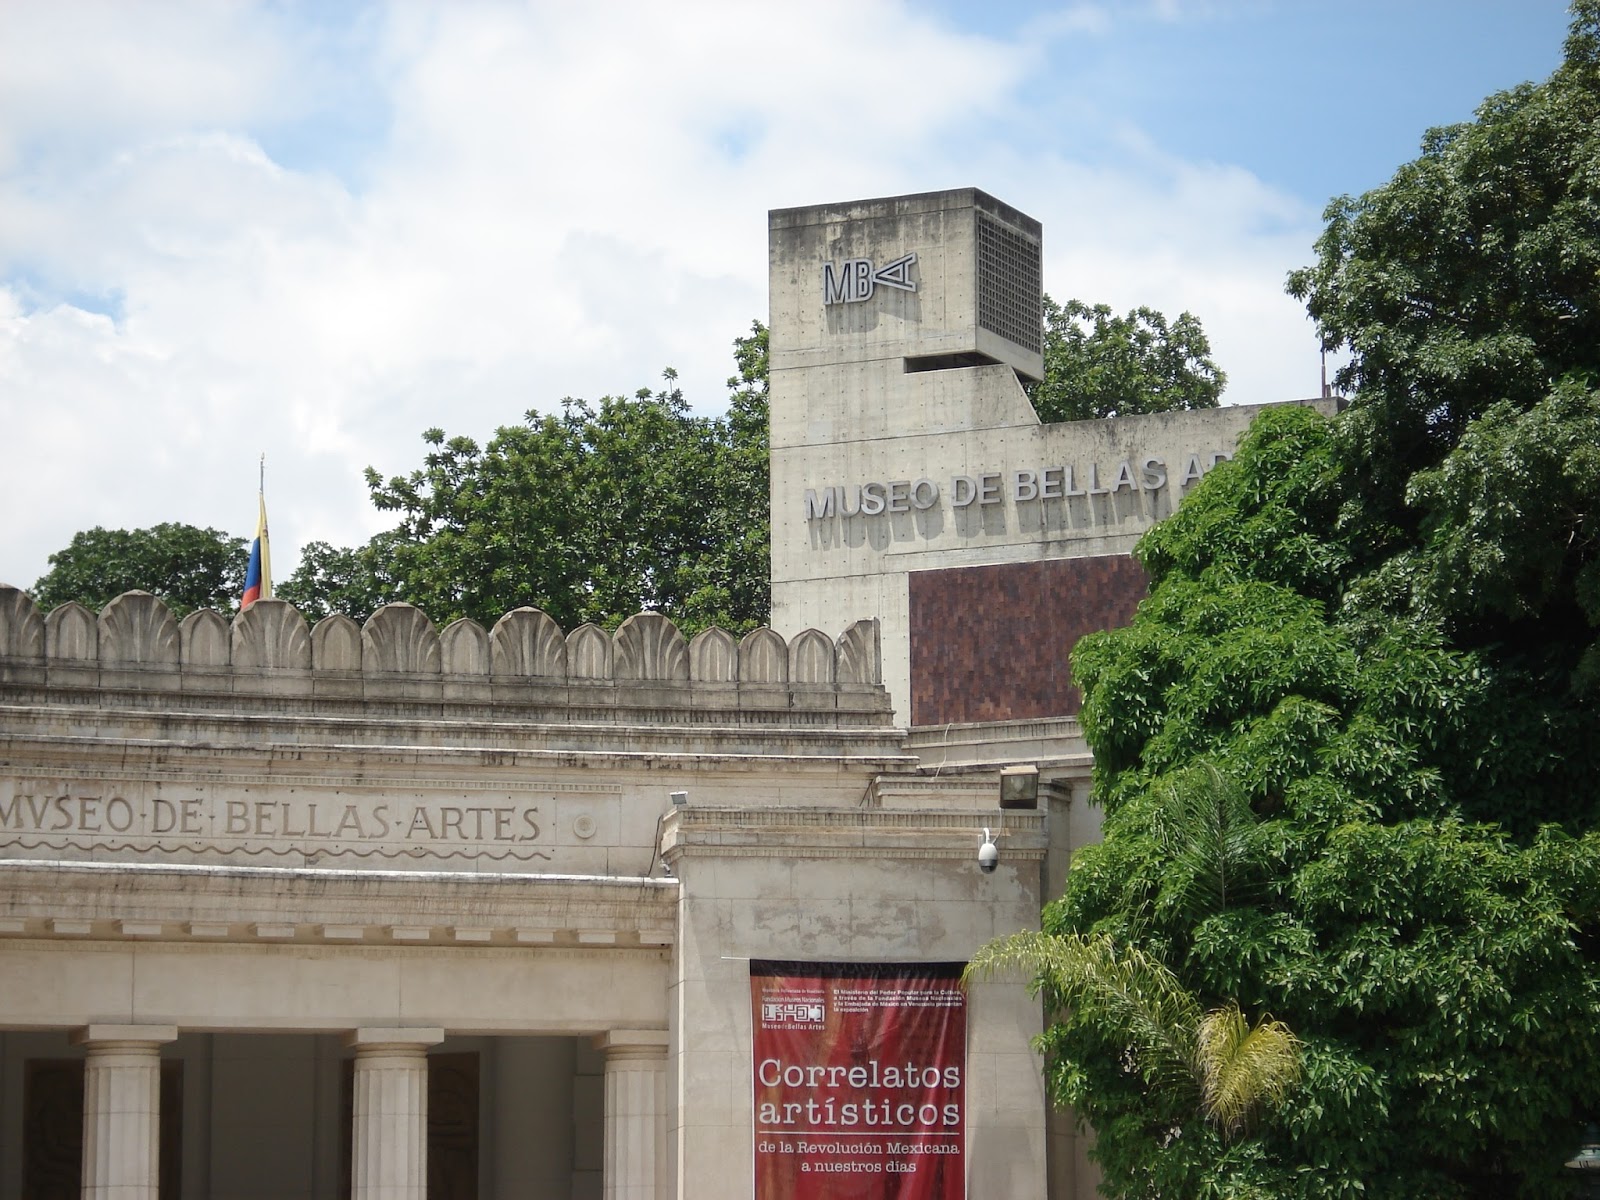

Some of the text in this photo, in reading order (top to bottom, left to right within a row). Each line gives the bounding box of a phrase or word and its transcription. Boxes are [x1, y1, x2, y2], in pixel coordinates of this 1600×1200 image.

[823, 252, 917, 305] MBA
[804, 478, 940, 520] MUSEO
[951, 472, 1001, 507] DE
[1013, 456, 1167, 501] BELLAS
[151, 799, 203, 833] DE
[225, 800, 389, 839] BELLAS
[405, 806, 541, 842] ARTES
[759, 1059, 961, 1088] Correlatos
[759, 1097, 960, 1126] artísticos
[758, 1141, 960, 1155] de la Revolución Mexicana
[801, 1161, 917, 1173] a nuestros días
